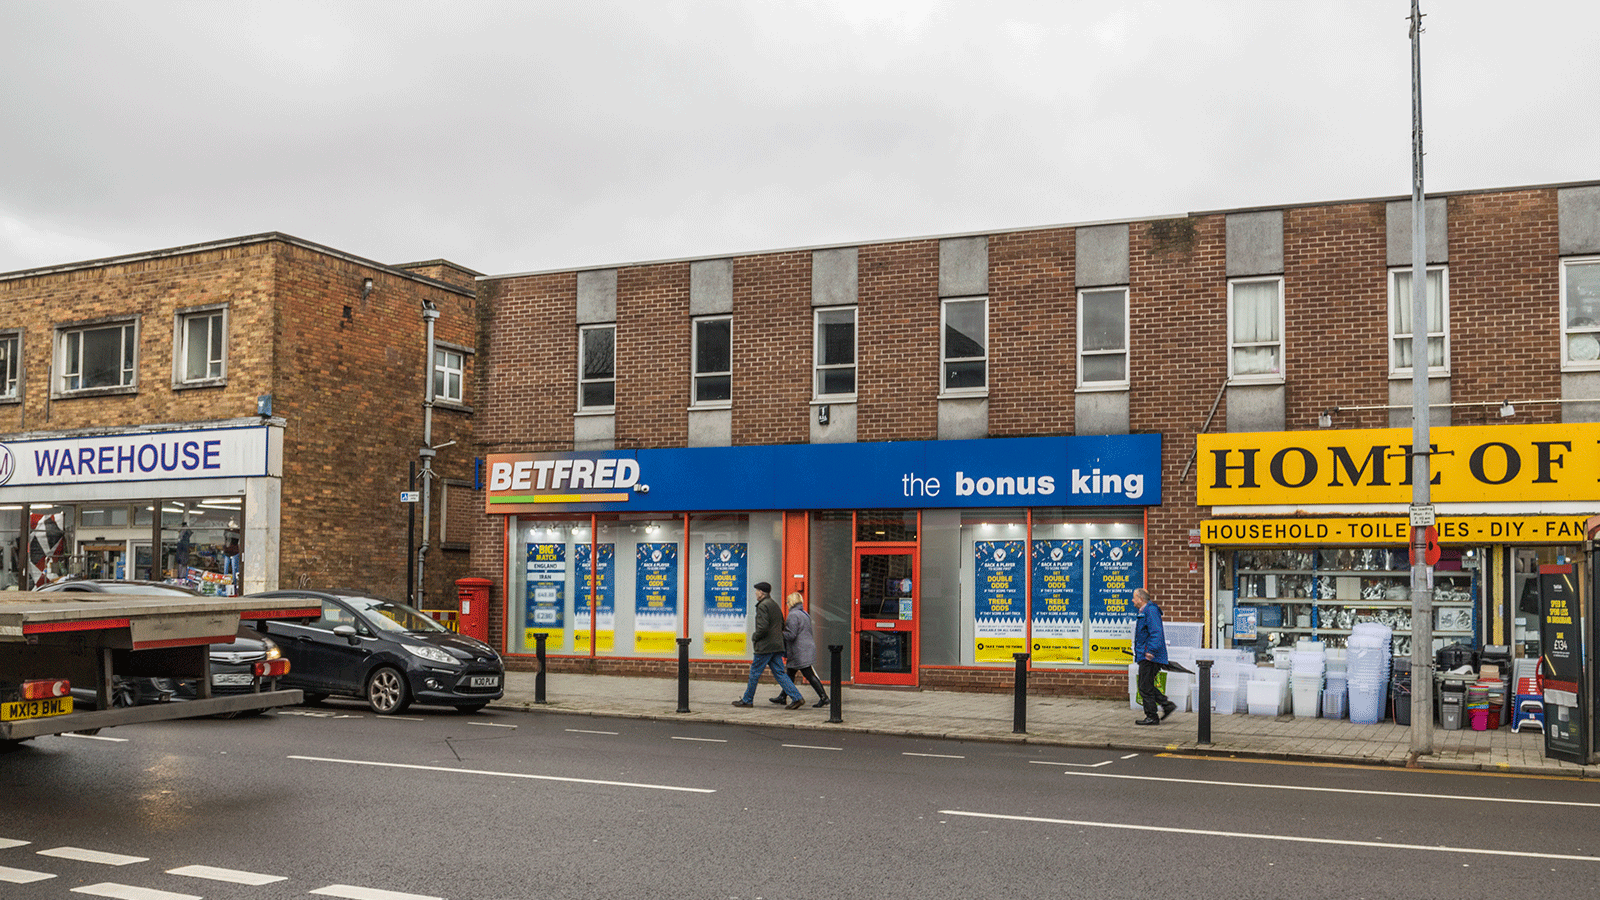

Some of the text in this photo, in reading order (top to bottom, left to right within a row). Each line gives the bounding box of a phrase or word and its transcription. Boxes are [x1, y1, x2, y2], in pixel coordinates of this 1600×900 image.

[34, 440, 221, 477] WAREHOUSE
[1210, 444, 1441, 488] HOME
[1469, 441, 1572, 485] OF
[490, 458, 640, 492] BETFRED
[902, 468, 1144, 499] the bonus king
[1207, 524, 1328, 539] HOUSEHOLD
[1348, 522, 1469, 538] TOILEIES
[1491, 522, 1524, 537] DIY
[539, 545, 554, 554] BIG
[1554, 640, 1568, 650] £134
[10, 700, 65, 718] MX13 BWL
